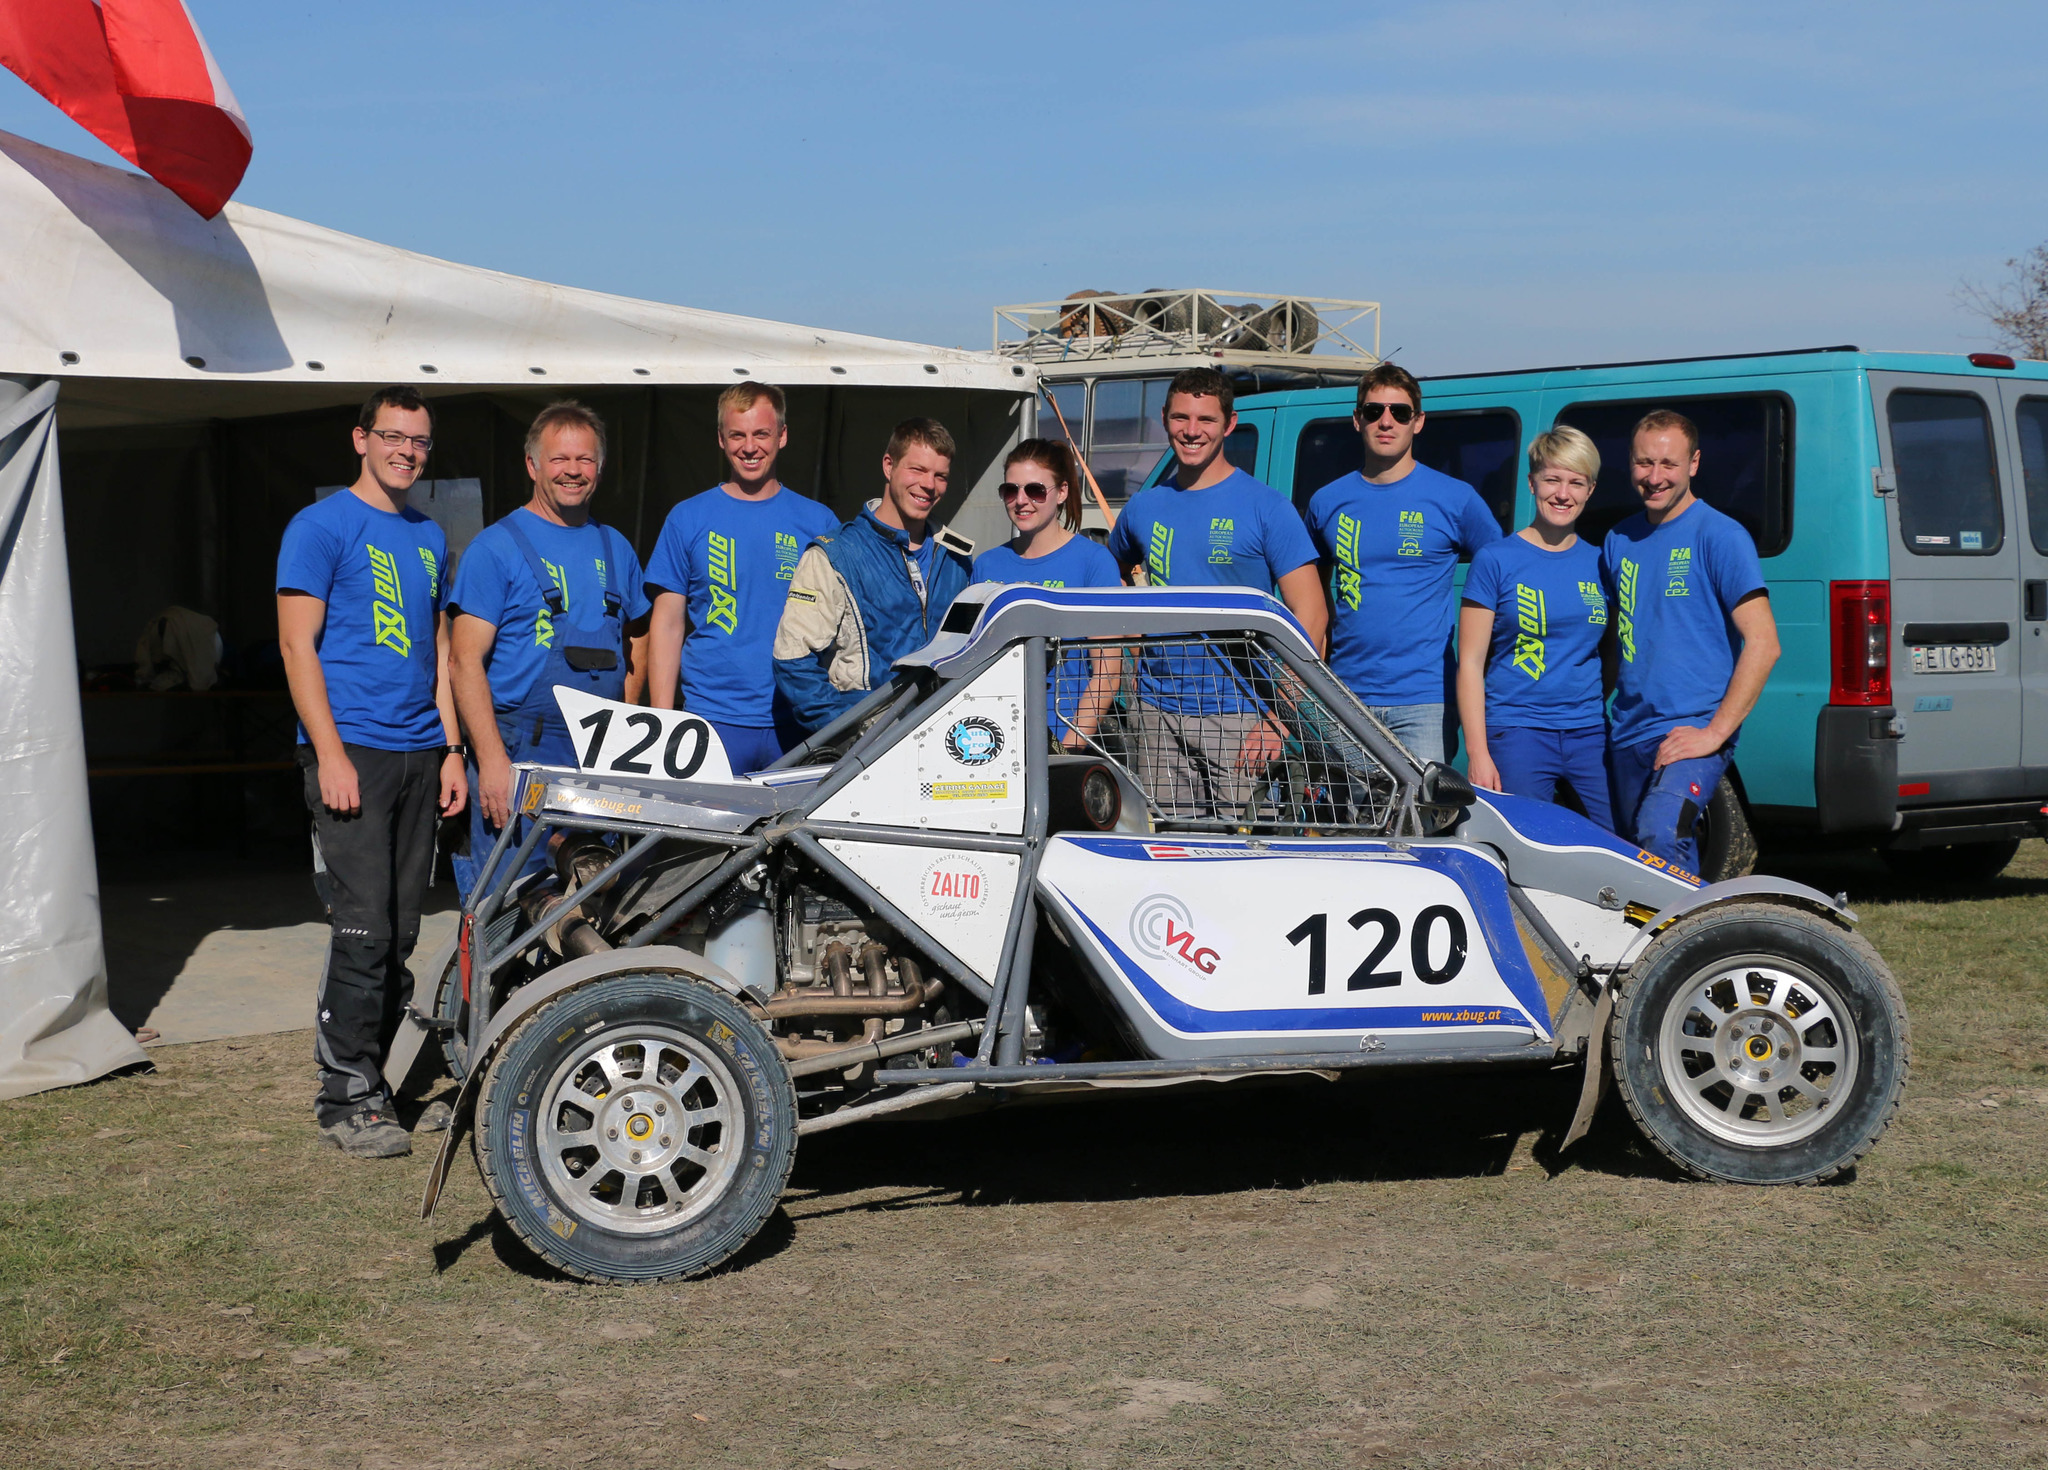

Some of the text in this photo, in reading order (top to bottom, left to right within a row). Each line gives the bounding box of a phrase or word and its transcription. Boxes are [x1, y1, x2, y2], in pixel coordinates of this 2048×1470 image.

[579, 709, 710, 780] 120
[931, 871, 980, 899] ZALTO
[1166, 918, 1222, 975] VLG
[1188, 967, 1207, 981] GROUP
[1285, 904, 1468, 996] 120
[1421, 1008, 1502, 1024] www.xbug.at
[511, 1111, 546, 1208] MICHELIN
